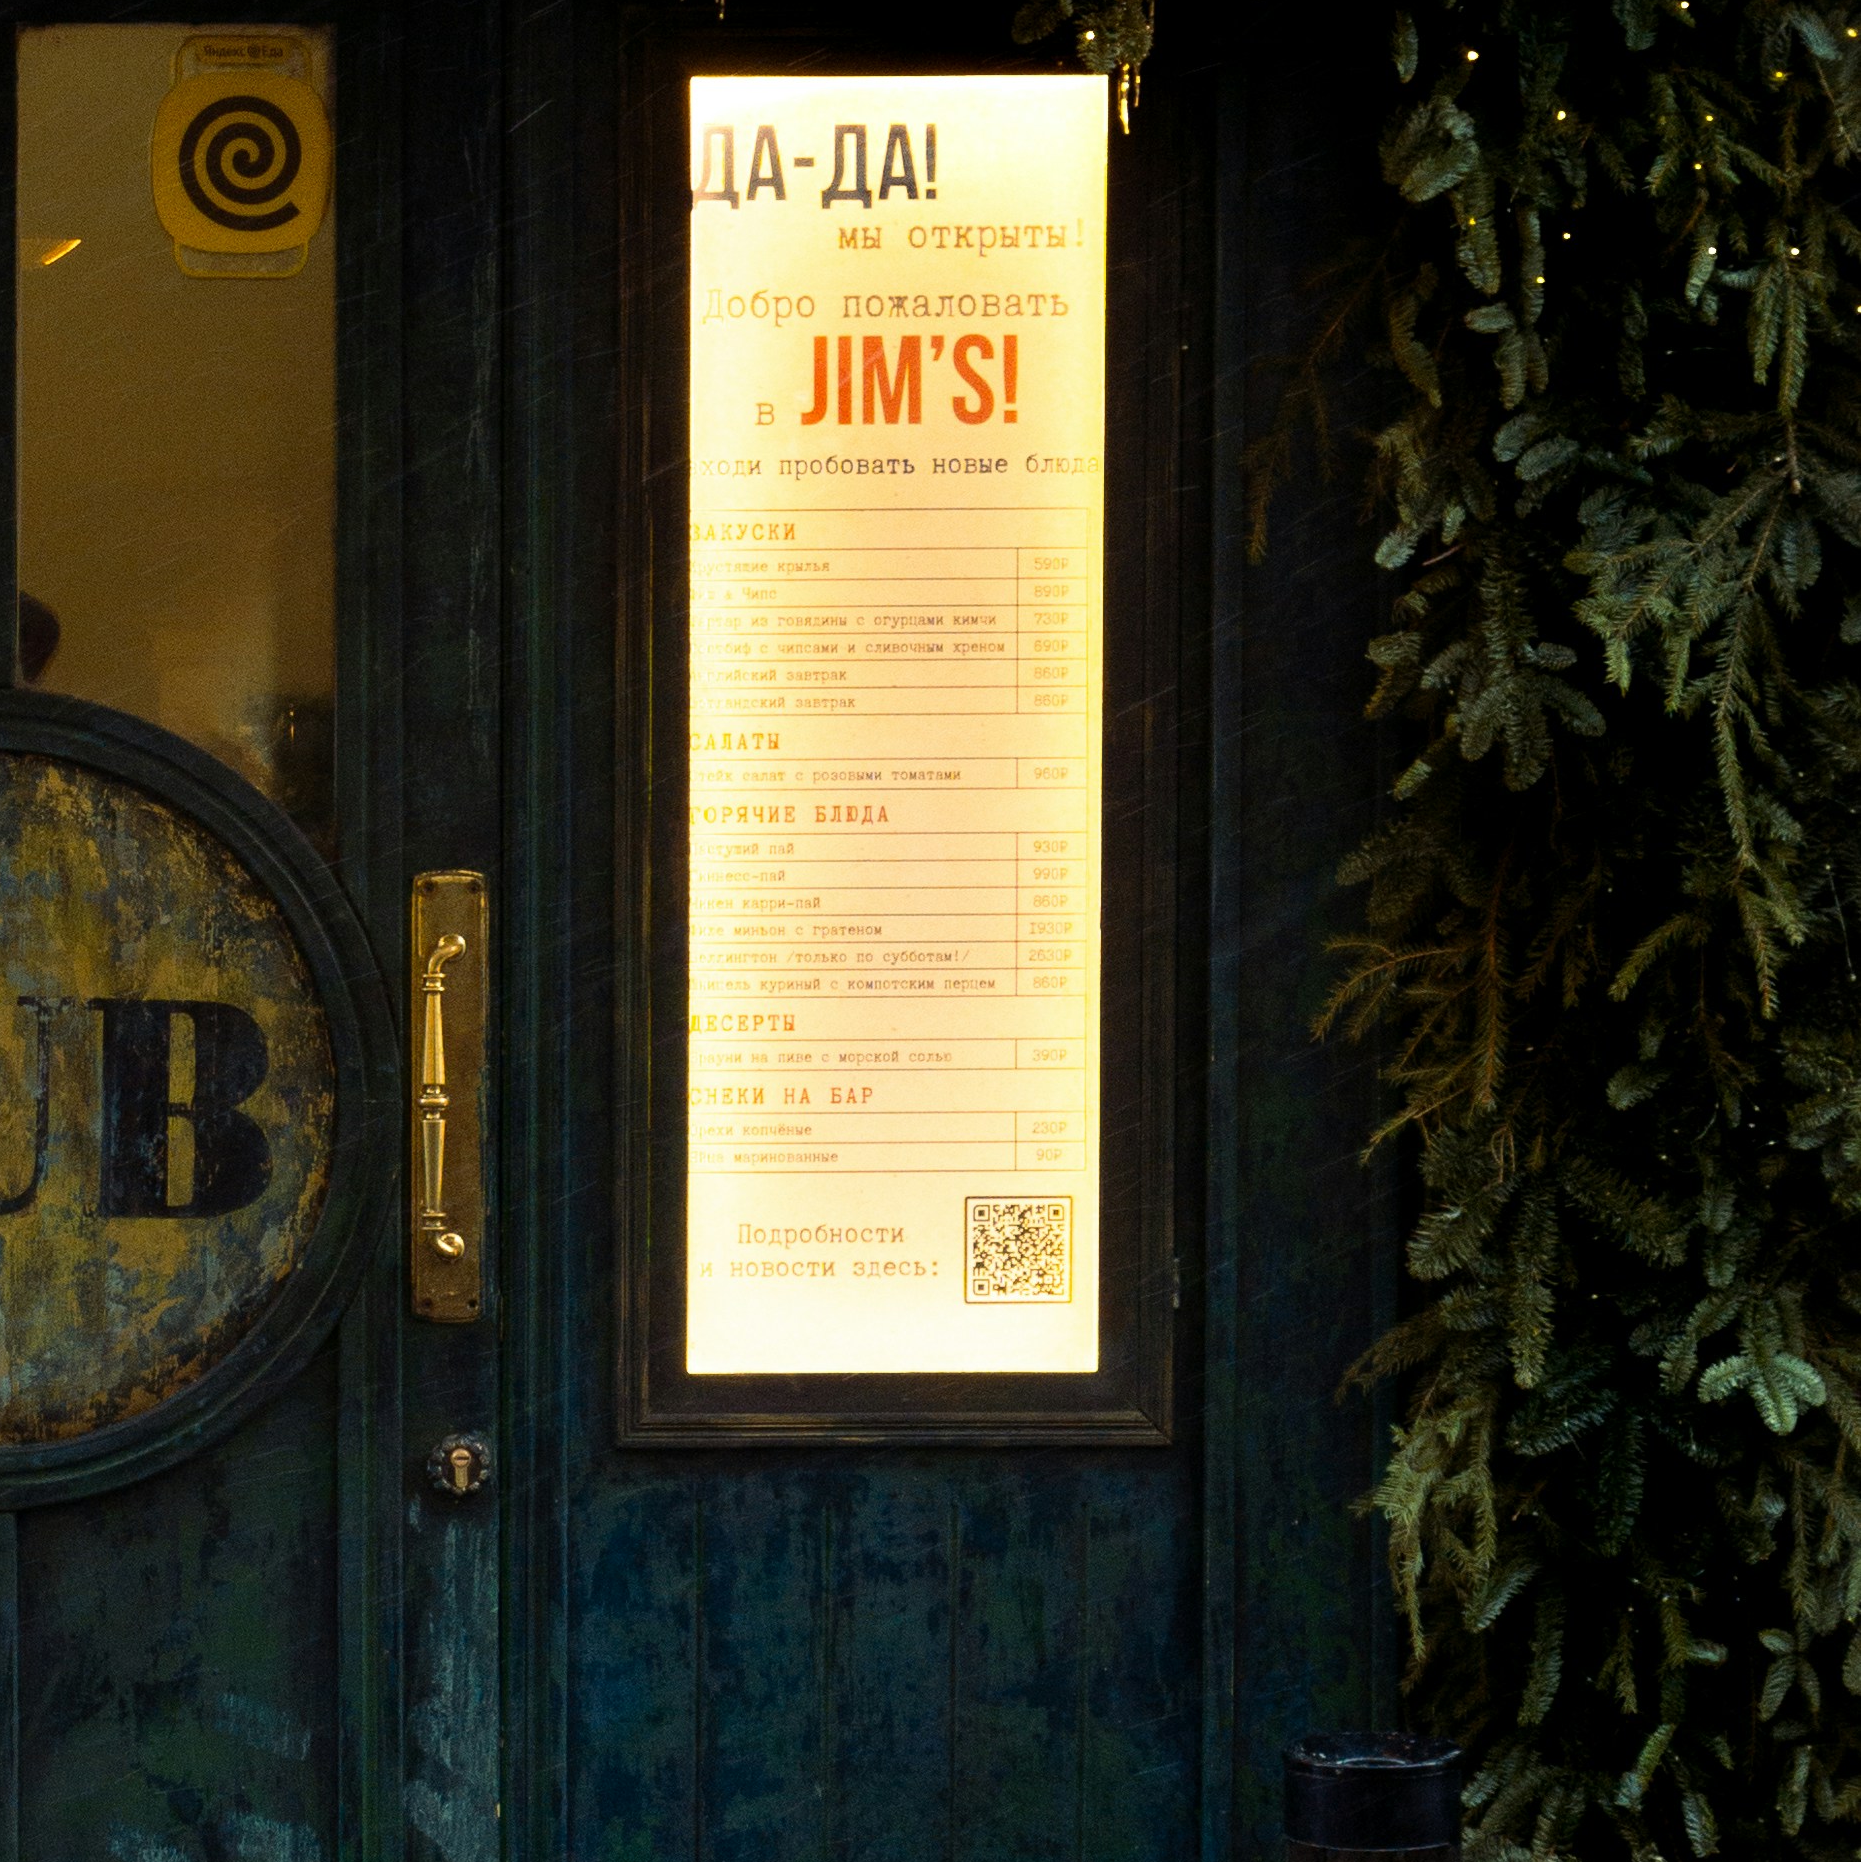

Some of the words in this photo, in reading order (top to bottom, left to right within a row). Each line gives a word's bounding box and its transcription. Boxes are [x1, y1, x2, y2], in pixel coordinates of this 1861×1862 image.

[692, 123, 938, 209] ДА-ДА!
[838, 226, 882, 249] мы
[909, 219, 1085, 257] открыты!
[703, 289, 816, 327] Добро
[843, 294, 1069, 319] пожаловать
[755, 403, 775, 426] в
[801, 334, 1019, 426] JIM’S!
[779, 455, 916, 480] пробовать
[933, 456, 1009, 474] новые
[1026, 453, 1100, 475] блюда
[691, 523, 796, 541] ЗАКУСКИ
[776, 560, 830, 575] крылья
[750, 615, 769, 627] из
[777, 614, 848, 628] говядины
[856, 615, 866, 626] с
[873, 614, 944, 629] огурцами
[952, 613, 997, 626] кимчи
[759, 643, 769, 654] с
[777, 642, 839, 654] чипсами
[847, 642, 857, 653] и
[865, 641, 944, 654] сливочным
[952, 641, 1006, 656] хреном
[786, 669, 848, 684] завтрак
[795, 696, 856, 711] завтрак
[691, 733, 781, 750] САЛАТЫ
[742, 769, 786, 782] салат
[795, 770, 805, 781] с
[812, 769, 883, 784] розовыми
[891, 768, 962, 781] томатами
[690, 805, 796, 825] ГОРЯЧИЕ
[815, 805, 889, 826] БЛЮДА
[768, 841, 795, 855] пай
[742, 896, 821, 913] карри-пай
[733, 923, 786, 936] миньон
[795, 925, 805, 936] с
[812, 923, 883, 938] гратеном
[856, 952, 874, 962] по
[760, 977, 821, 993] куриный
[830, 980, 839, 990] с
[943, 977, 996, 992] перцем
[690, 1014, 796, 1034] ДЕСЕРТЫ
[751, 1052, 769, 1063] на
[777, 1051, 813, 1063] пиве
[821, 1053, 830, 1063] с
[839, 1050, 900, 1066] морской
[908, 1051, 953, 1063] солью
[690, 1087, 766, 1106] СНЕКИ
[784, 1087, 812, 1105] НА
[830, 1087, 874, 1105] БАР
[733, 1150, 839, 1166] маринованные
[737, 1223, 905, 1247] Подробности
[700, 1263, 713, 1277] и
[730, 1260, 836, 1277] новости
[853, 1260, 939, 1280] здесь:
